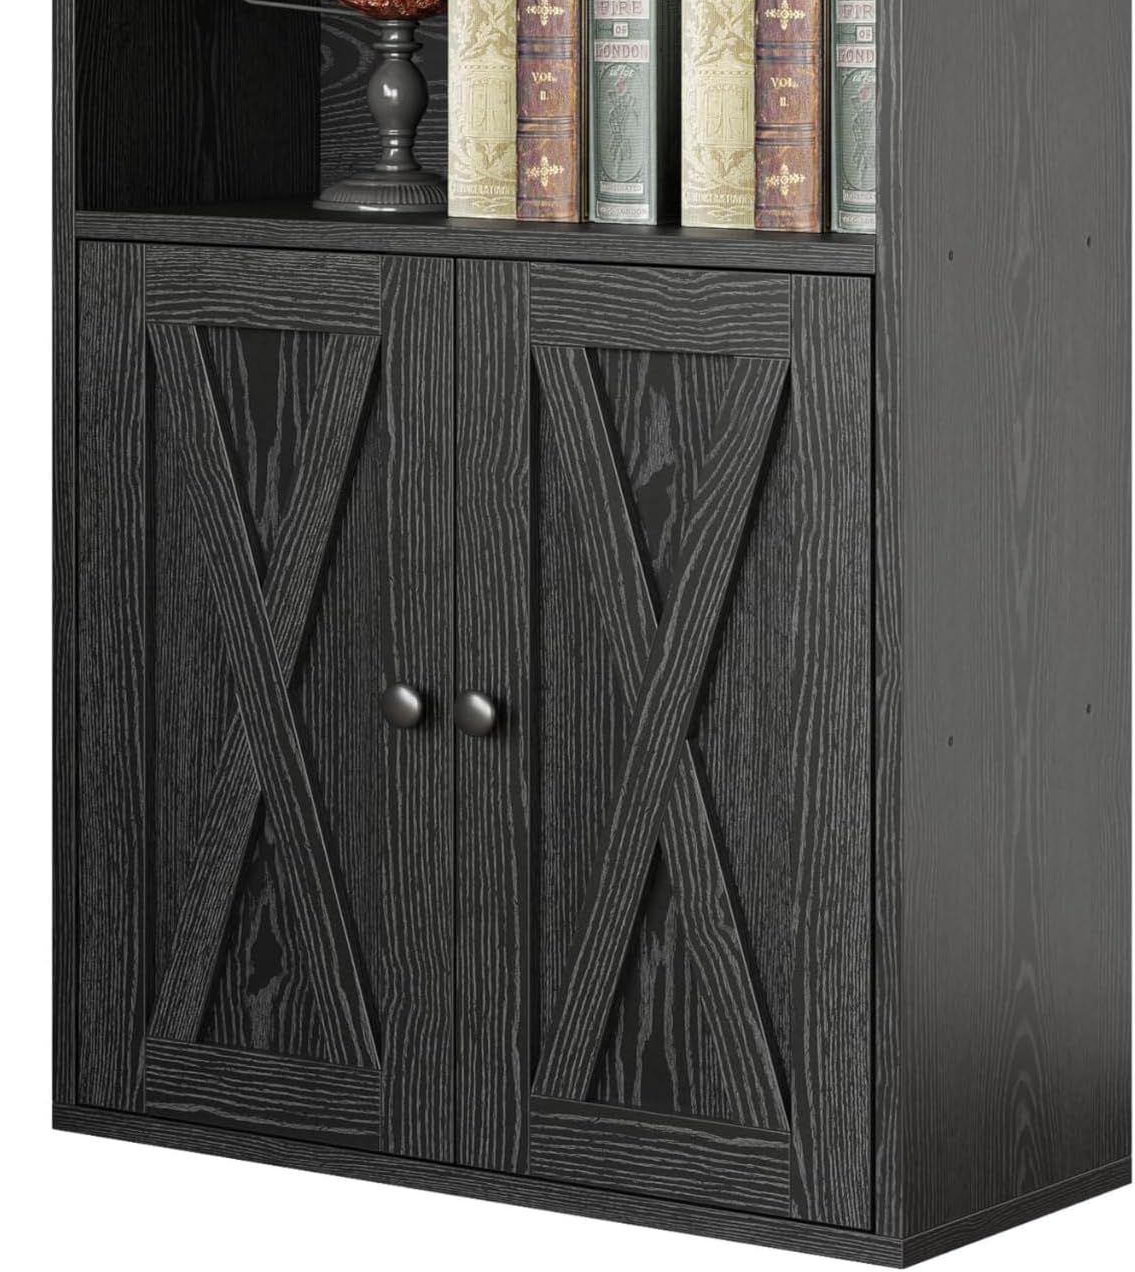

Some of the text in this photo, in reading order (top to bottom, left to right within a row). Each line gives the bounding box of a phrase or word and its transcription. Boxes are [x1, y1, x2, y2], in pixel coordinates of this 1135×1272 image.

[599, 0, 643, 15] FIRE
[842, 4, 874, 18] FIR
[839, 49, 874, 63] LOND
